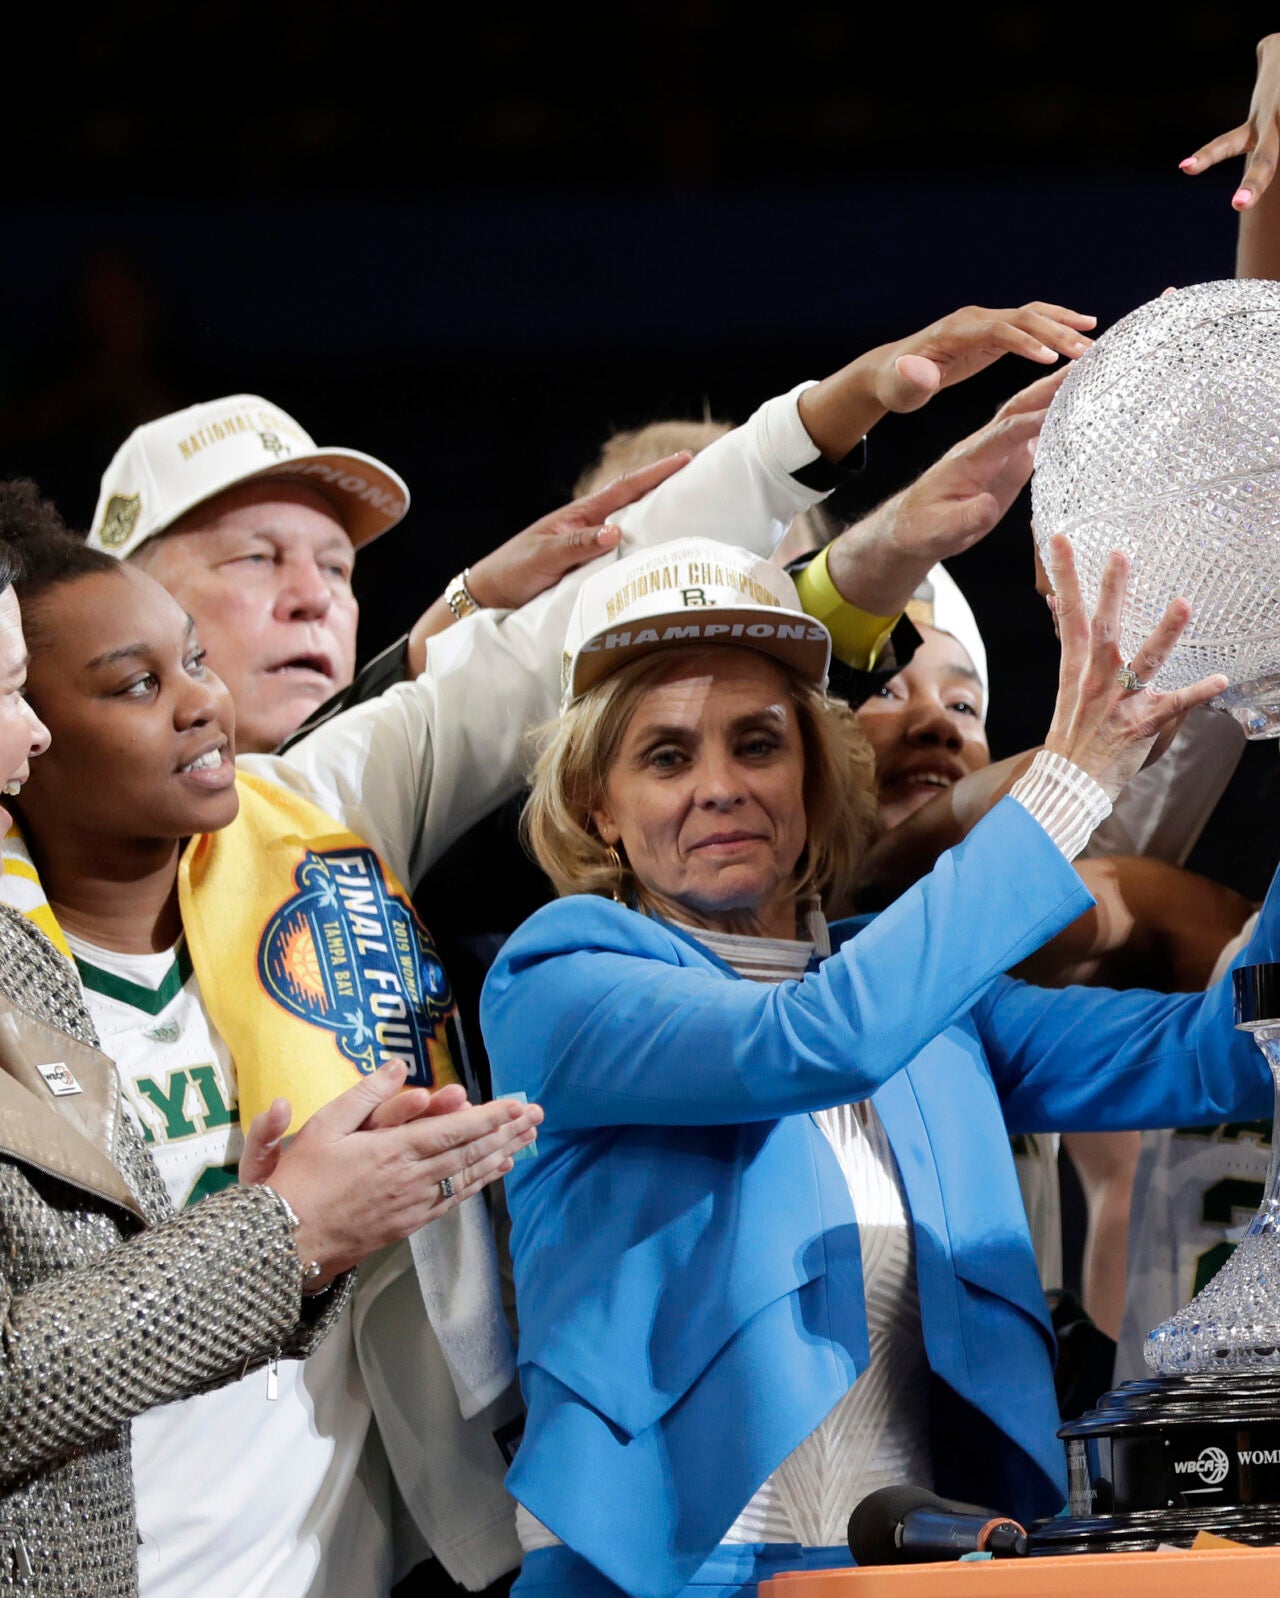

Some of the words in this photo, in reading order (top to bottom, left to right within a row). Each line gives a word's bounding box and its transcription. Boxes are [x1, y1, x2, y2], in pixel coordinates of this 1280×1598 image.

[178, 415, 254, 462] NATIONAL
[605, 565, 681, 622] NATIONAL
[688, 562, 781, 608] CHAMPIONS
[581, 624, 826, 652] CHAMPIONS
[325, 855, 388, 955] FINAL
[323, 921, 346, 966] TAMPA
[392, 920, 410, 952] 2019
[334, 971, 354, 998] BAY
[1174, 1460, 1215, 1474] WBCA
